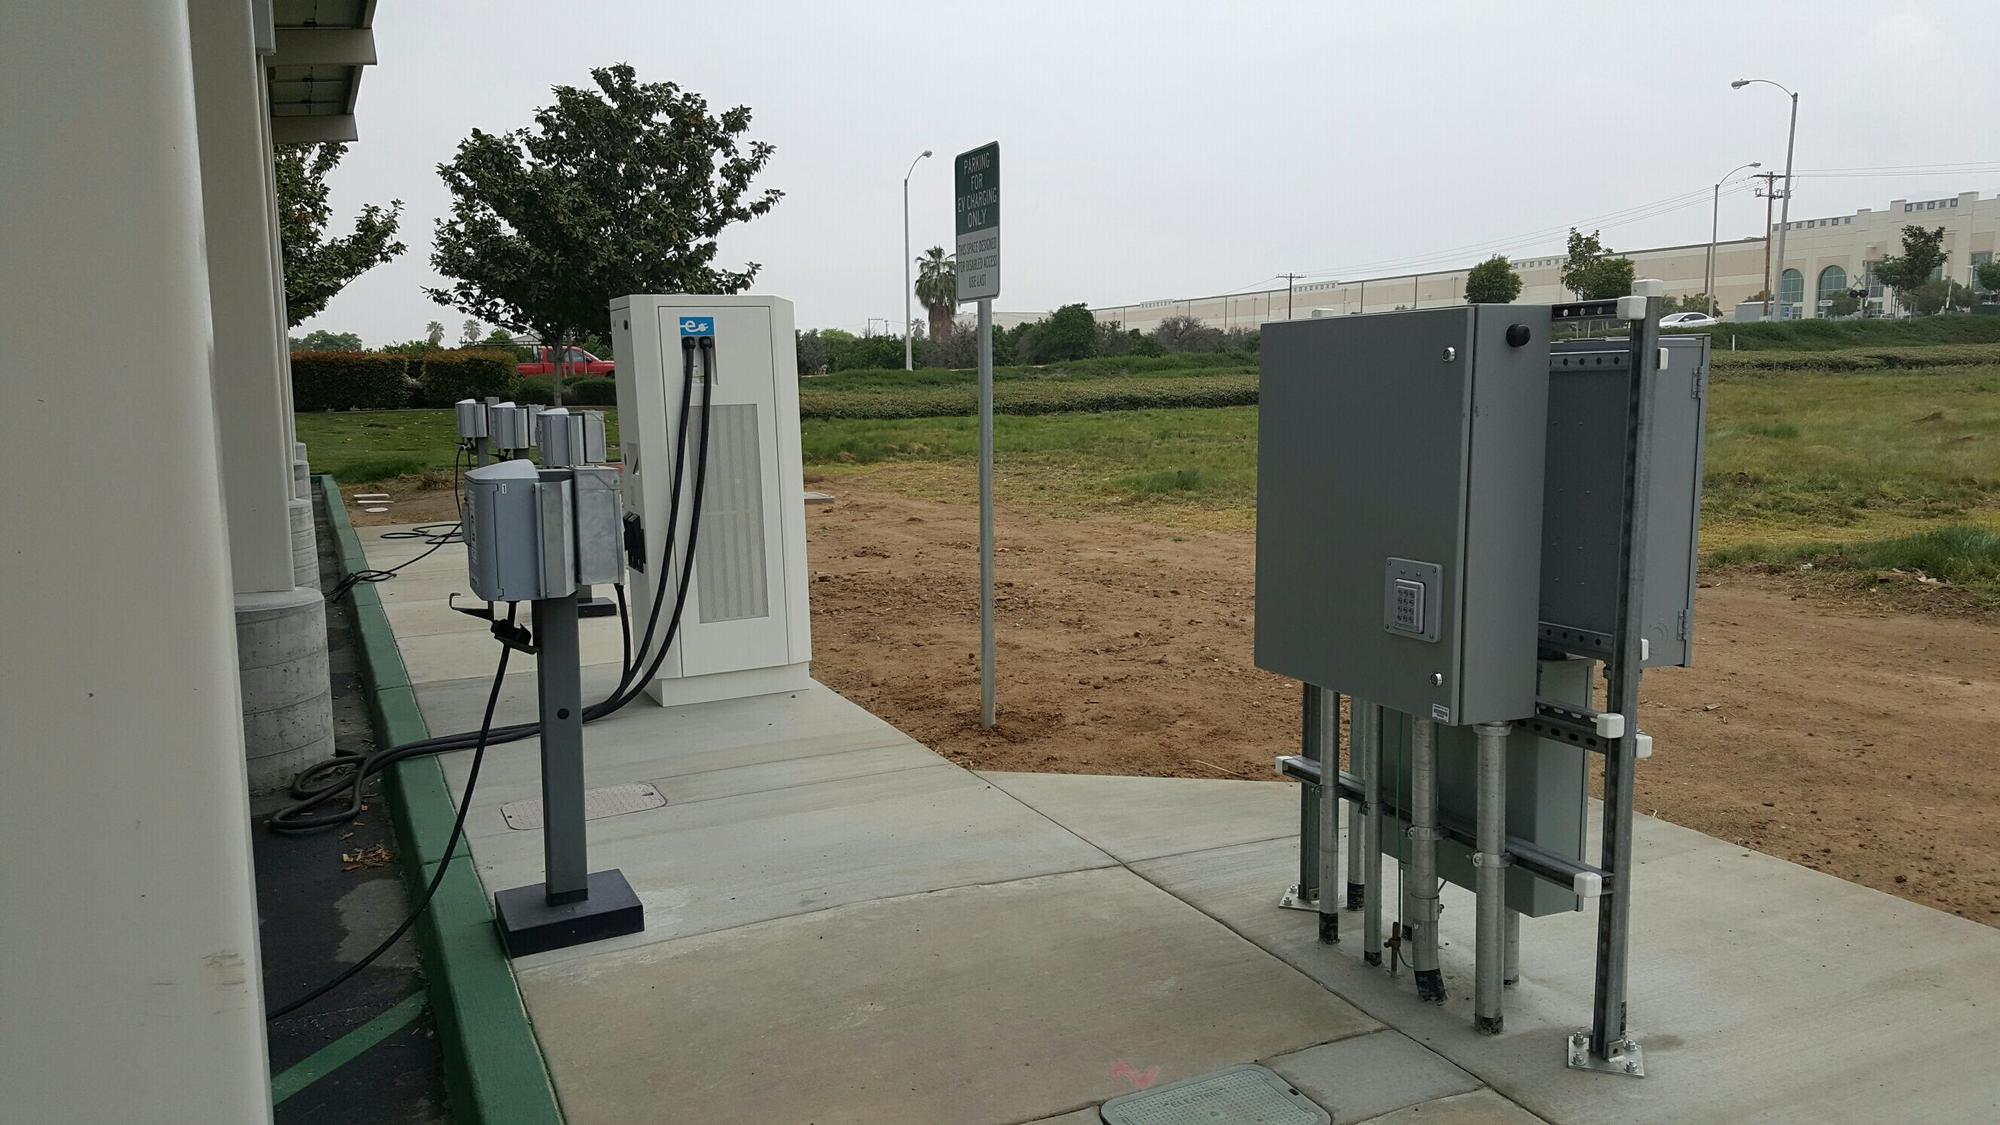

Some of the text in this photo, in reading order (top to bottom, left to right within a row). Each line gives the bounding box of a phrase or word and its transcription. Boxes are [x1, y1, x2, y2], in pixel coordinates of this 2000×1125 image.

[964, 152, 989, 176] PARKING
[971, 173, 983, 191] FOR
[958, 187, 997, 213] EV CHARGING
[967, 208, 987, 228] ONLY
[958, 242, 966, 256] THIS
[967, 240, 978, 254] SPACE
[958, 254, 997, 273] FOR DISABLED ACCESS
[968, 273, 987, 288] USE LAST
